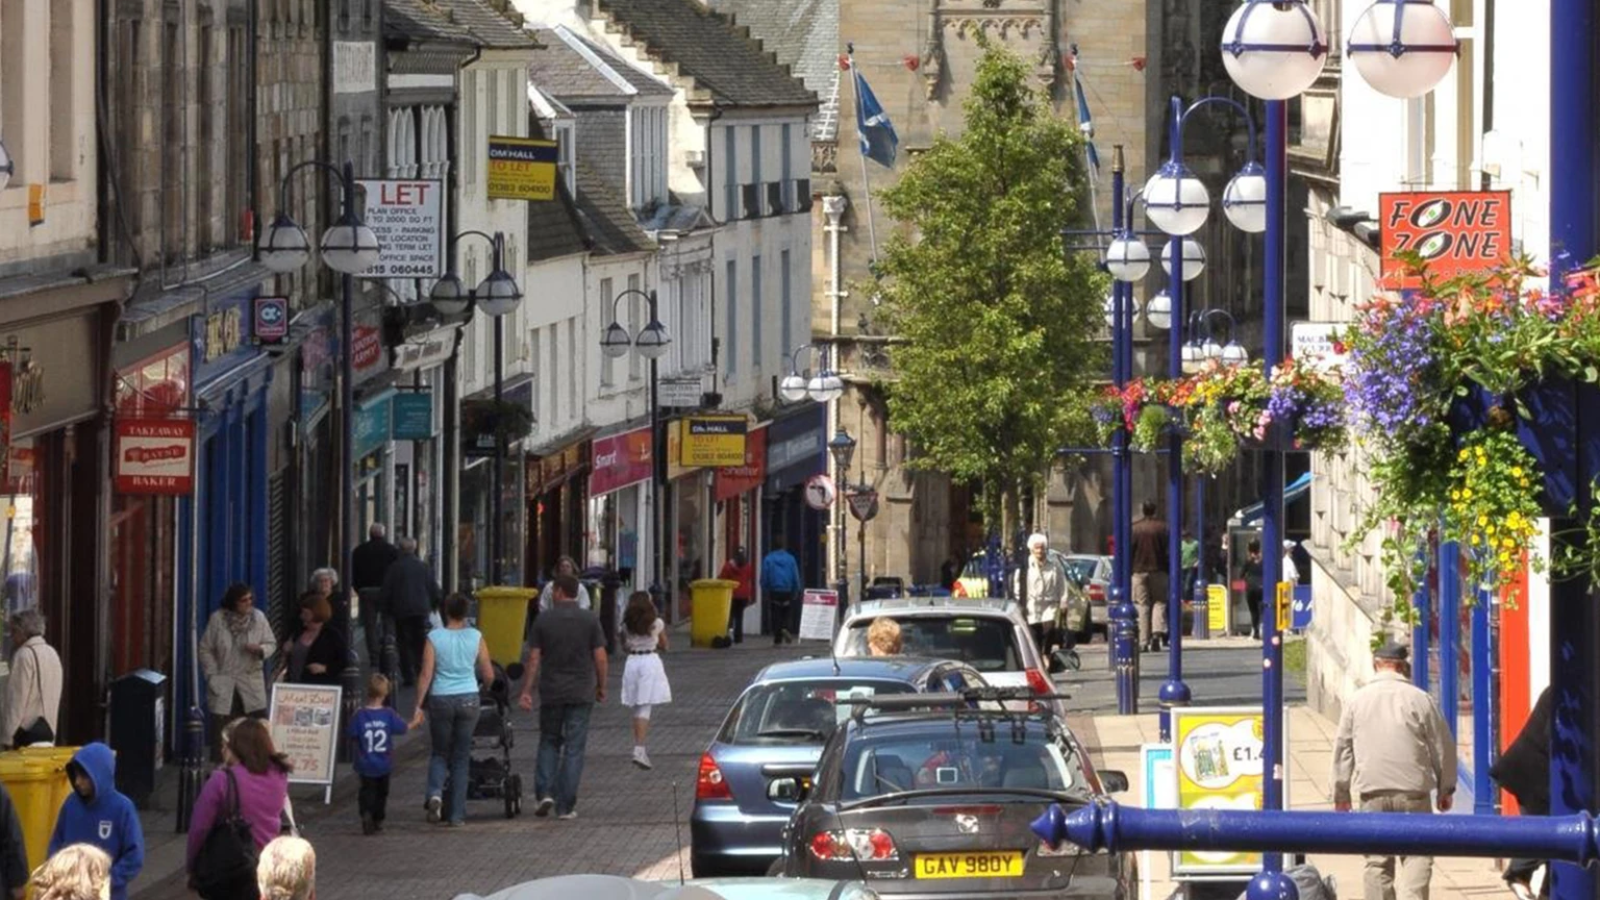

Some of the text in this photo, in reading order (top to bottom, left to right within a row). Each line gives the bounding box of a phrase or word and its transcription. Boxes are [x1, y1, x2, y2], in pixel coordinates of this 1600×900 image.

[492, 160, 531, 171] TO LET
[381, 184, 430, 205] LET
[409, 216, 420, 224] SQ
[1390, 199, 1500, 228] FONE
[1391, 230, 1500, 259] ZONE
[390, 265, 433, 274] 060445
[129, 426, 185, 436] TAKEAWAY
[132, 477, 176, 486] BAKER
[364, 729, 387, 752] 12
[924, 857, 960, 874] GAV
[965, 855, 1013, 873] 980Y
